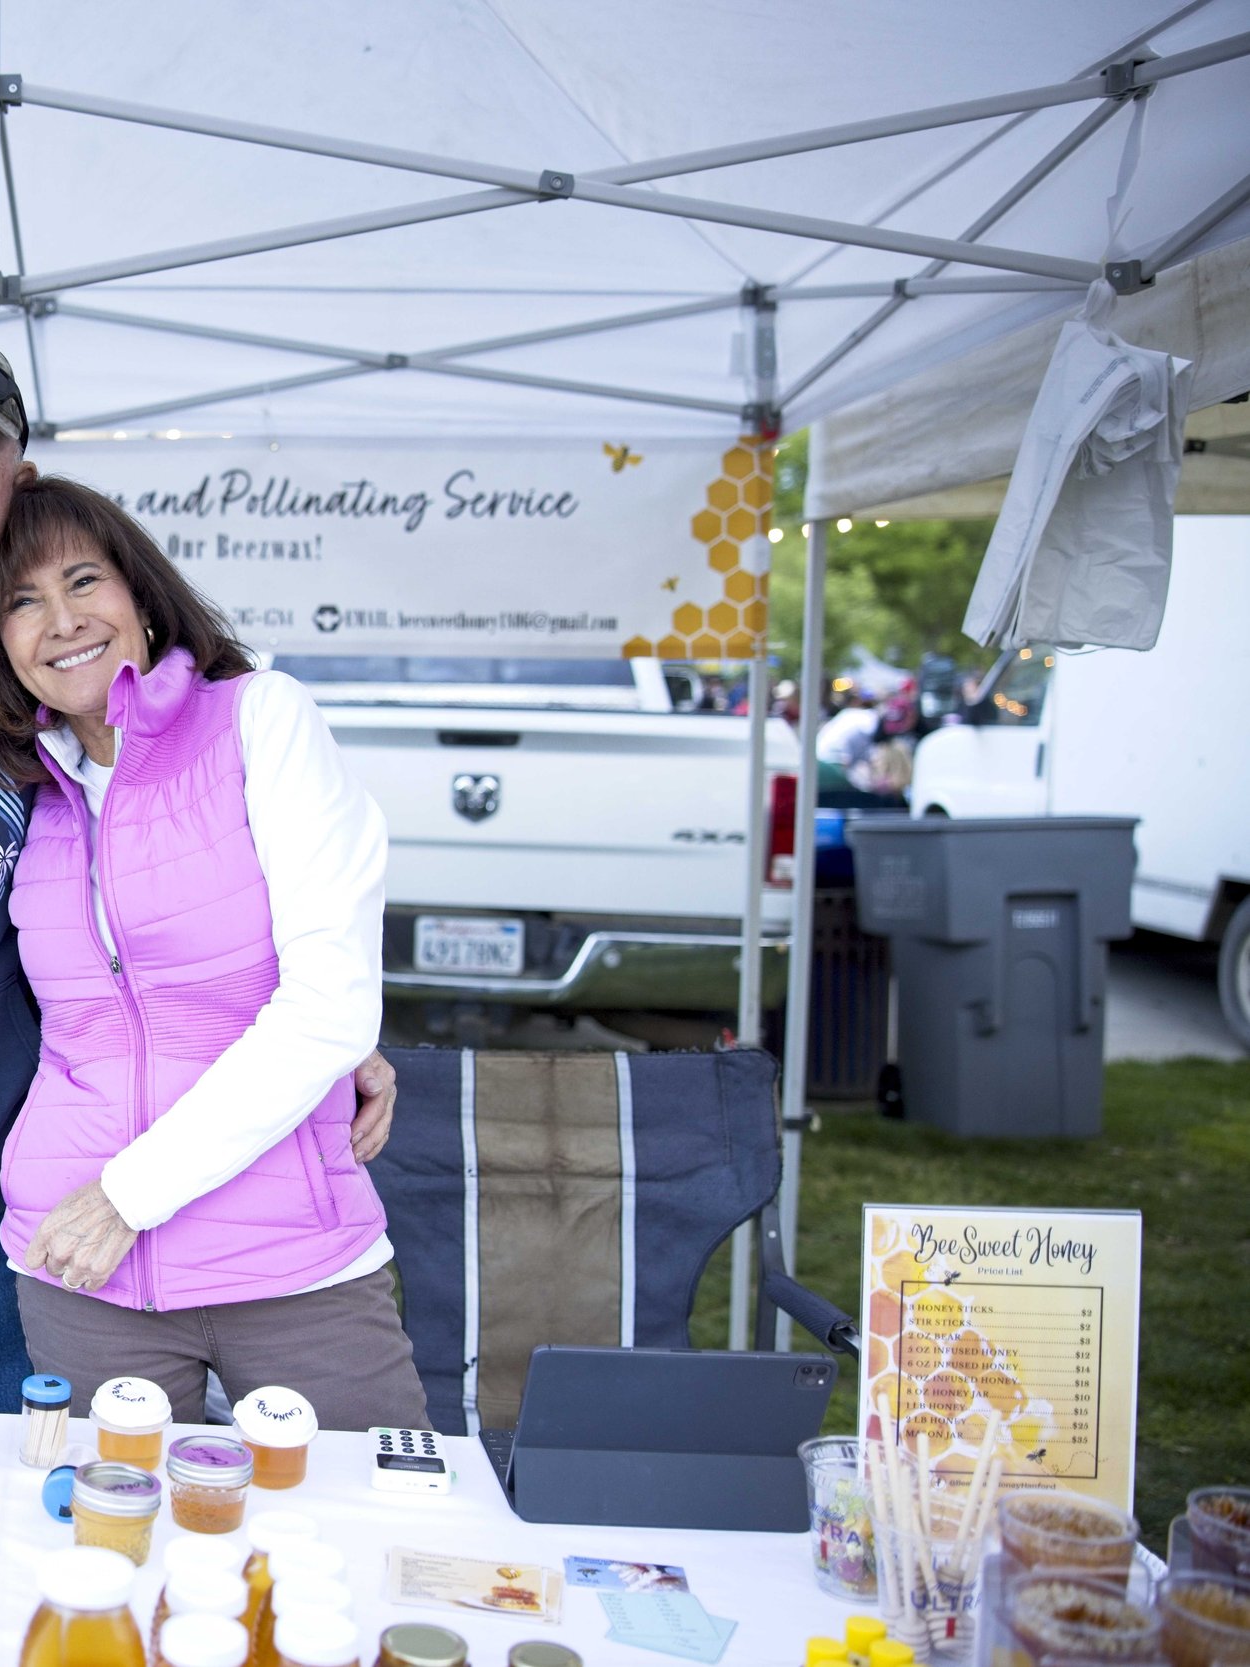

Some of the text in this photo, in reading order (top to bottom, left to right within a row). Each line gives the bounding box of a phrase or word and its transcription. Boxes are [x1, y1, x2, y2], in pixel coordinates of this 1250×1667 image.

[136, 468, 580, 533] and Pollinating Service
[911, 1223, 1097, 1275] BeeSweet Honey
[917, 1304, 955, 1313] HONEY
[957, 1305, 994, 1313] STICKS
[1081, 1309, 1092, 1317] $2
[908, 1317, 1091, 1331] STIR STICKS $2
[916, 1332, 932, 1340] OZ
[934, 1332, 961, 1341] BEAR
[915, 1346, 930, 1354] OZ
[933, 1346, 979, 1356] INFUSED
[981, 1348, 1018, 1357] HONEY
[1075, 1351, 1090, 1360] $12
[915, 1360, 930, 1368] OZ
[933, 1360, 979, 1370] INFUSED
[981, 1362, 1019, 1371] HONEY
[1075, 1365, 1090, 1374] $14
[933, 1375, 978, 1383] INFUSED
[981, 1376, 1018, 1385] HONEY
[1074, 1379, 1090, 1387] $18
[914, 1388, 929, 1396] OZ
[932, 1389, 970, 1397] HONEY
[971, 1390, 989, 1398] JAR
[1074, 1393, 1090, 1402] $10
[929, 1402, 966, 1411] HONEY
[1073, 1408, 1089, 1416] $15
[930, 1416, 967, 1425] HONEY
[1072, 1421, 1089, 1430] $25
[905, 1429, 1088, 1444] MAON JAR $35
